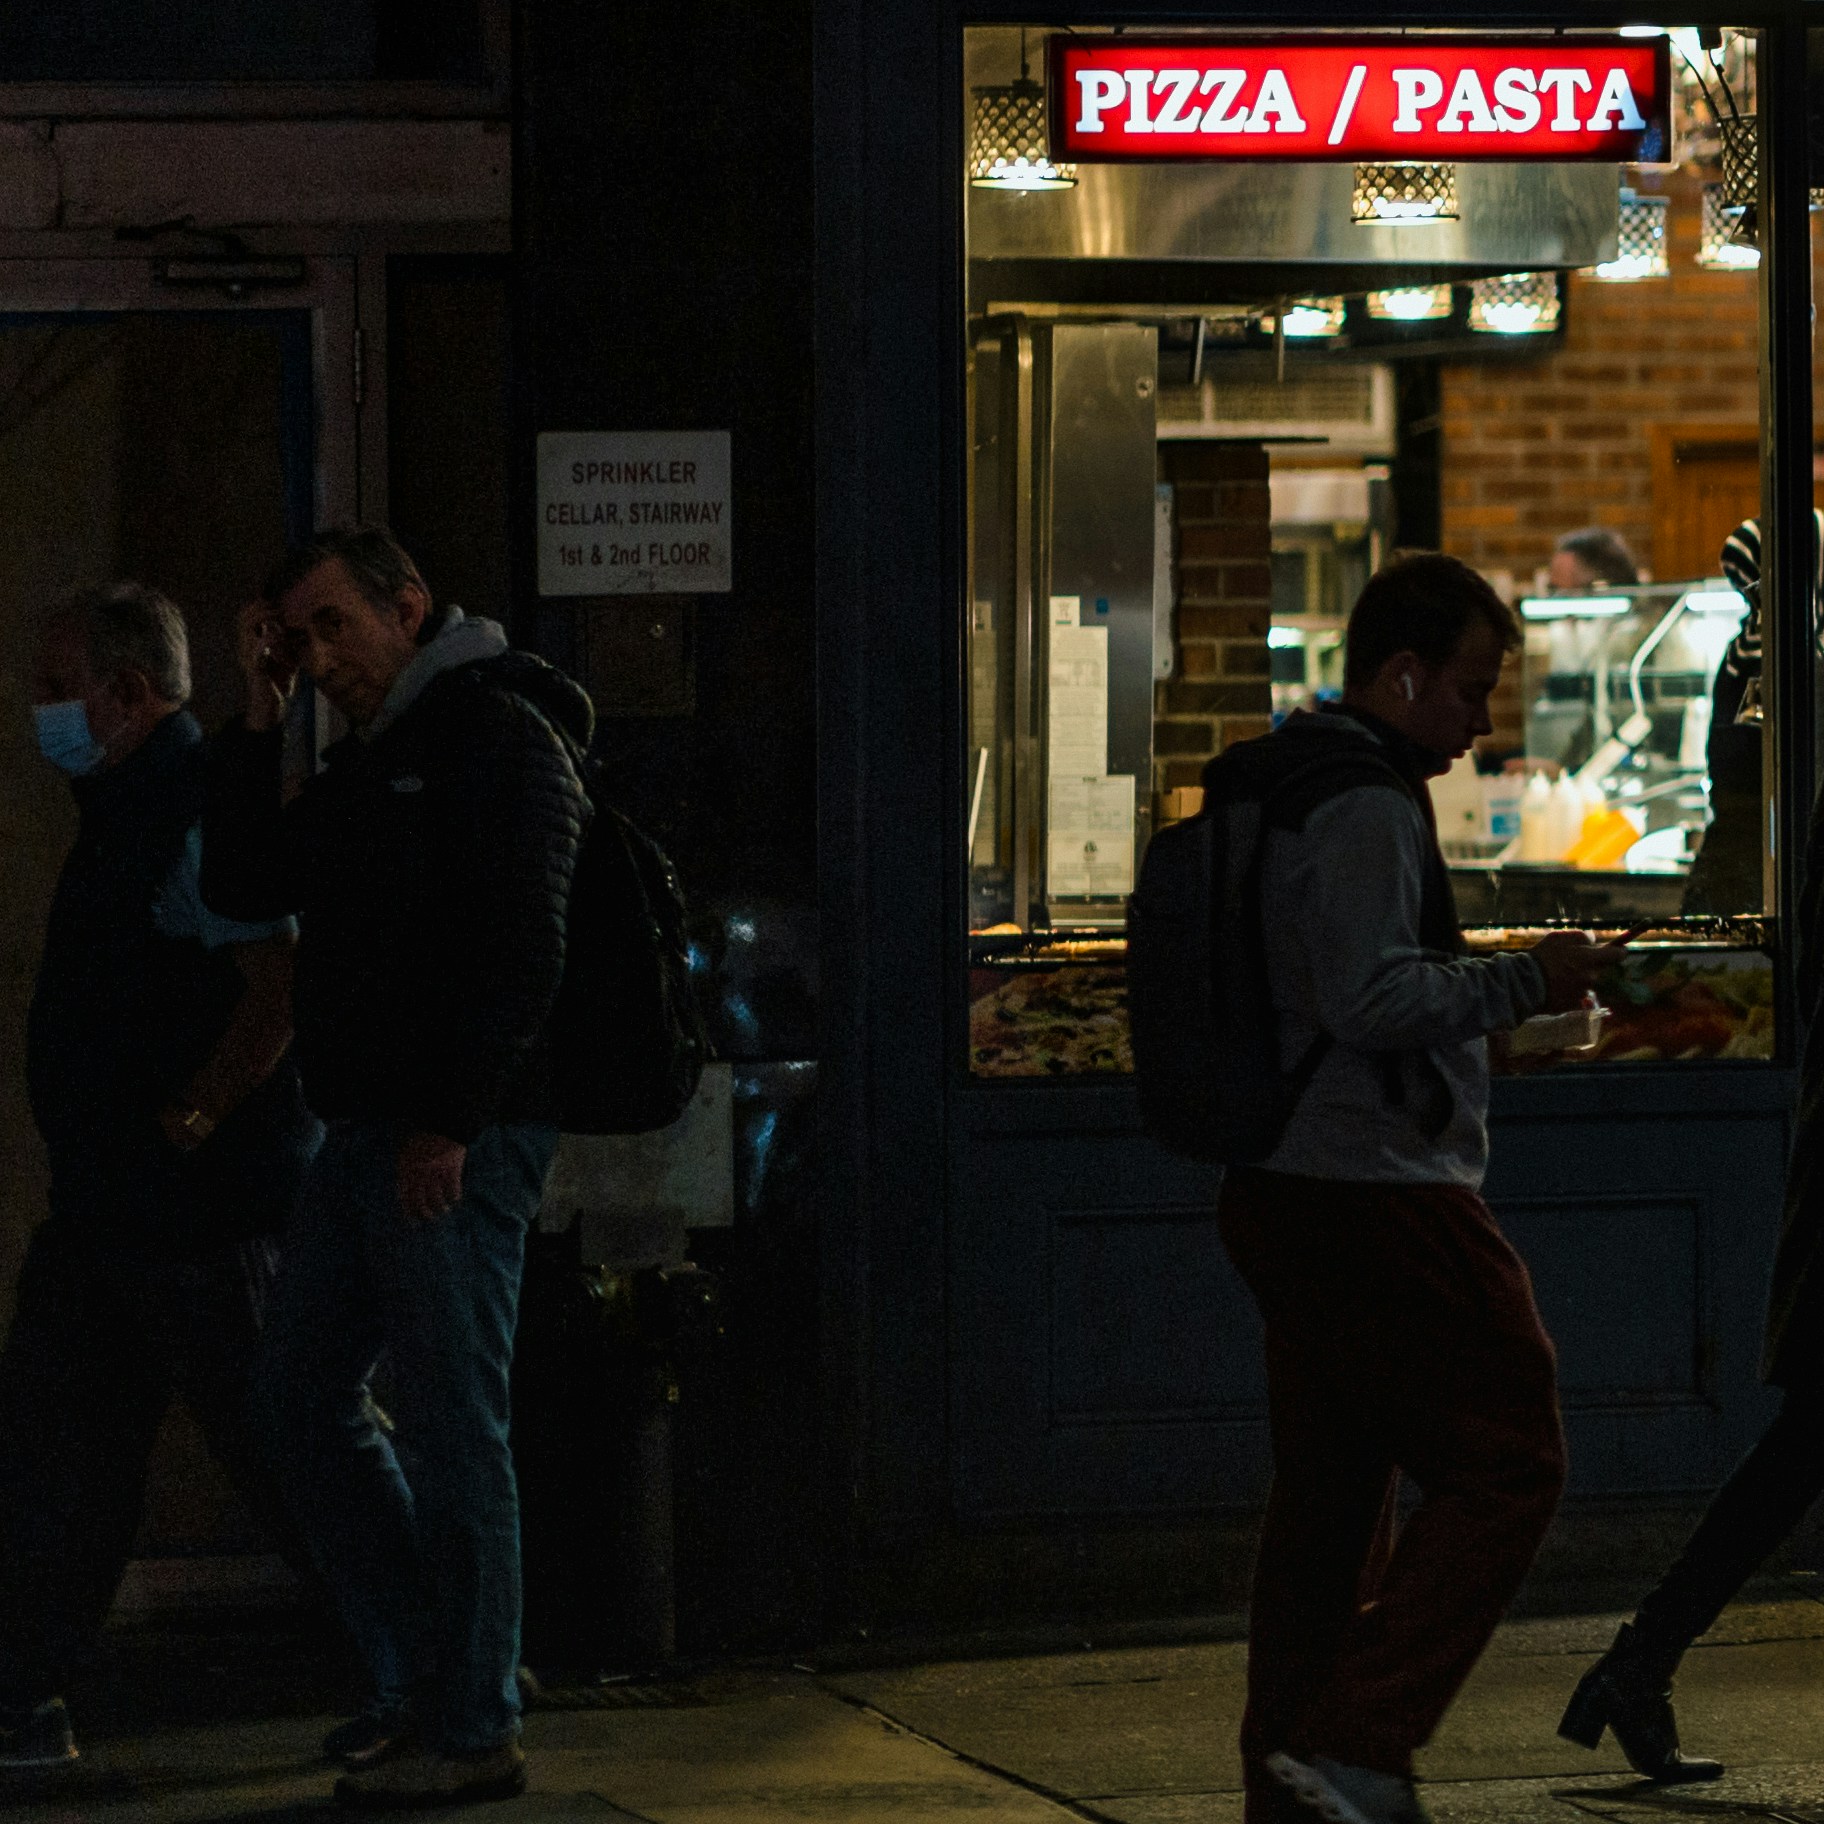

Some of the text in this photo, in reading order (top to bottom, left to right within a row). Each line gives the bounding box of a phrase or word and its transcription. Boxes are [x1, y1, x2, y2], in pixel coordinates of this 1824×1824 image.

[1074, 68, 1307, 134] PIZZA
[1391, 67, 1647, 134] PASTA
[571, 461, 697, 485] SPRINKLER
[545, 502, 723, 528] CELLAR, STAIRWAY
[560, 541, 711, 566] 1st & 2nd FLOOR
